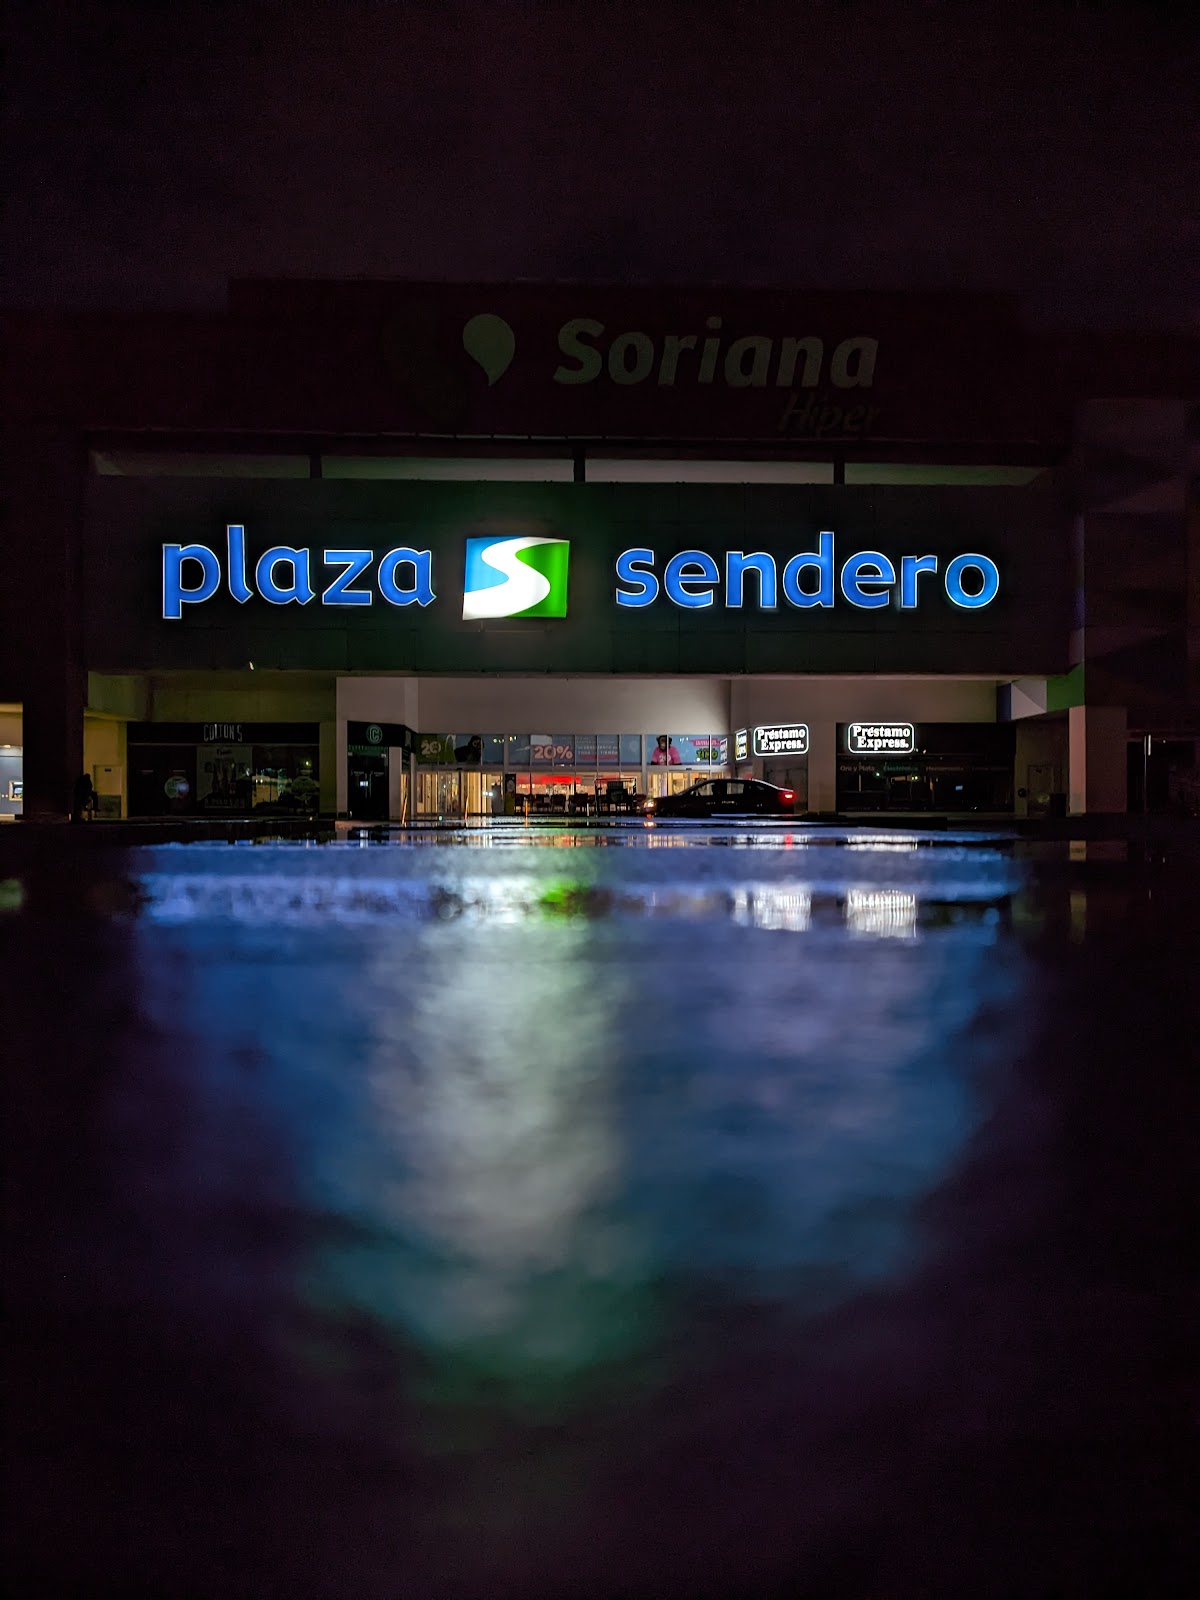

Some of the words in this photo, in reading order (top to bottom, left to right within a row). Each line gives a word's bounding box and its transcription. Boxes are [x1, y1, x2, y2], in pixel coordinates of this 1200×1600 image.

[552, 315, 880, 389] Soriana
[162, 524, 438, 620] plaza
[615, 531, 1000, 609] sendero
[533, 744, 574, 760] 20%
